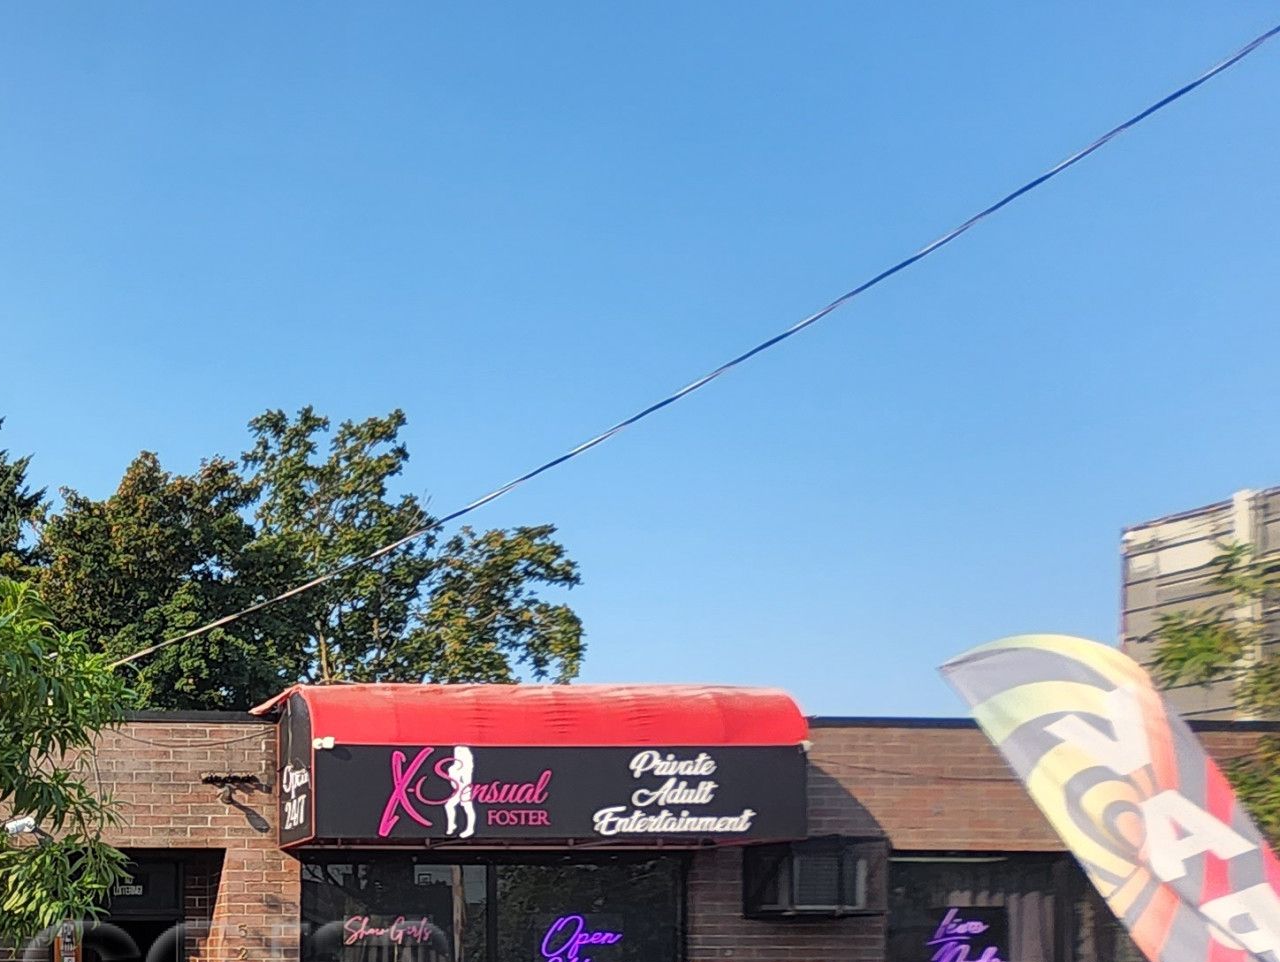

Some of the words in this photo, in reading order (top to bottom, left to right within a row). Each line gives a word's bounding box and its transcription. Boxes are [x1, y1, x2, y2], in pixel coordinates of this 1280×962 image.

[629, 750, 718, 778] Private
[282, 765, 311, 799] Open
[631, 777, 719, 807] Adult
[487, 810, 551, 825] FOSTER
[592, 806, 757, 835] Entertainment
[540, 914, 623, 958] Open
